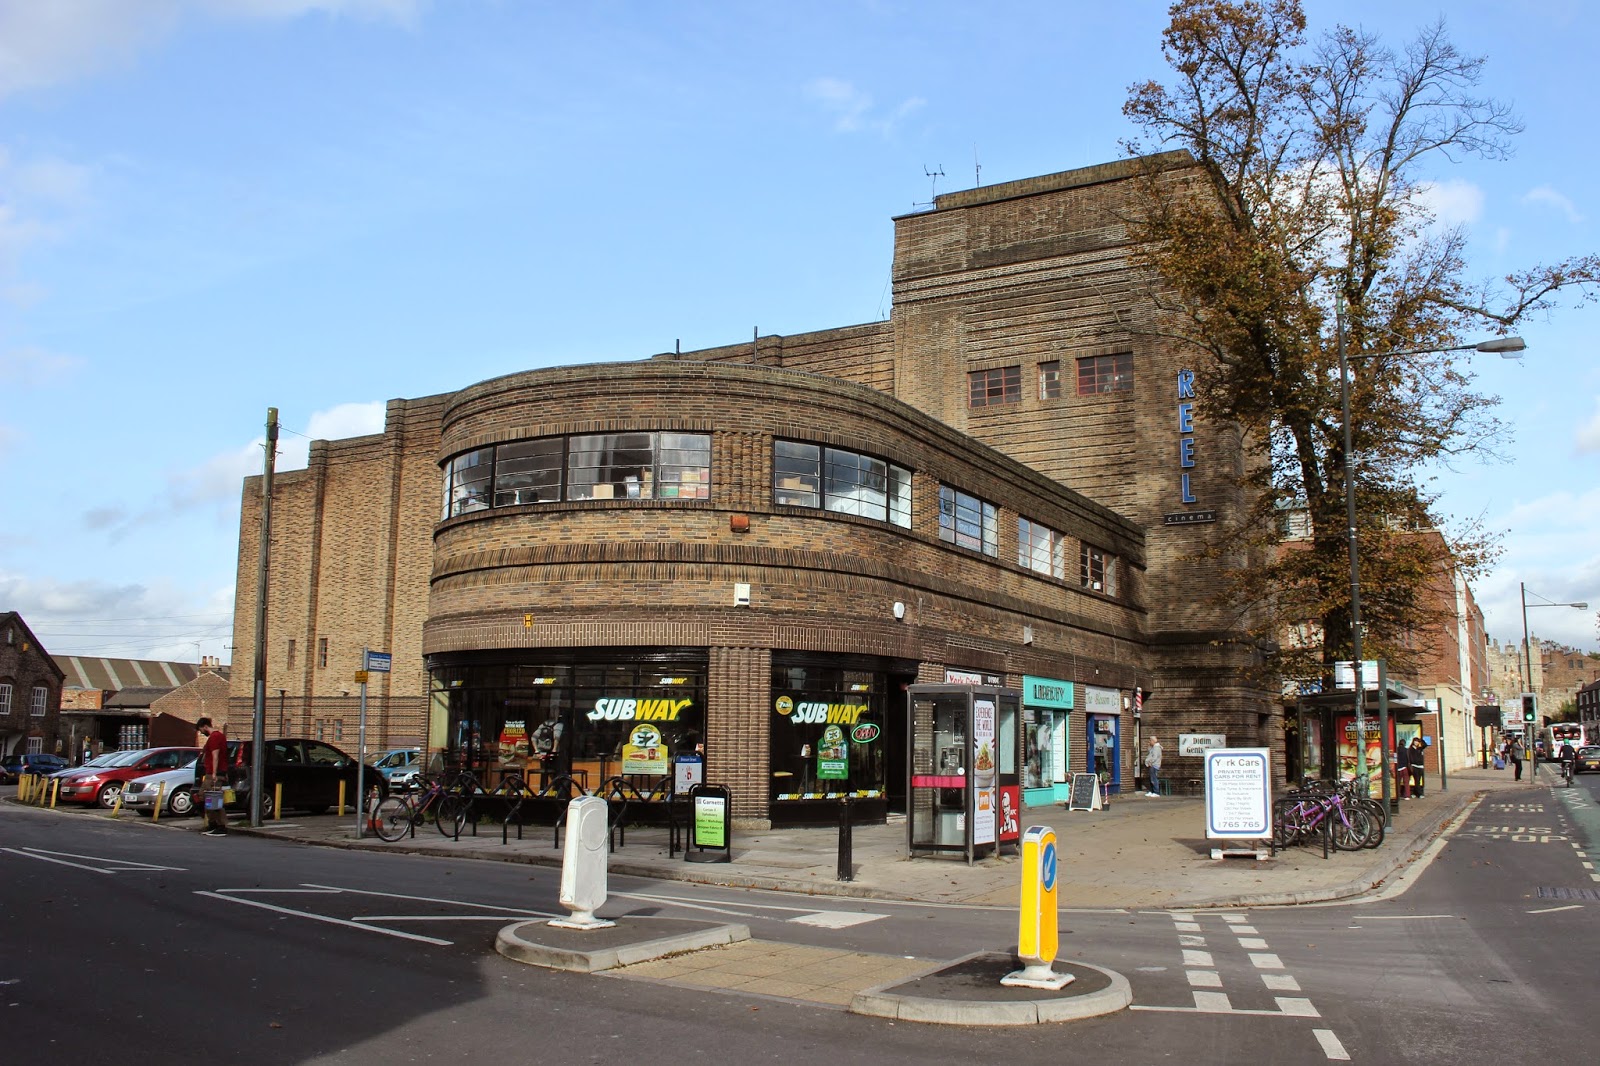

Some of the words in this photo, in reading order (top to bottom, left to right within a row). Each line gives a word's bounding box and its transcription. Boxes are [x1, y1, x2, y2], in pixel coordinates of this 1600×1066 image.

[1177, 368, 1197, 503] REEL
[1167, 513, 1212, 522] cinema
[659, 677, 688, 685] SUBWAY
[1033, 684, 1065, 702] LIBERTY
[587, 698, 692, 720] SUBWAY
[791, 702, 867, 724] SUBWAY
[631, 732, 660, 748] £2
[826, 729, 841, 741] £3
[855, 727, 876, 740] OPEN
[1192, 737, 1212, 745] Didim
[1215, 758, 1236, 767] Yrk
[1238, 758, 1260, 767] Cars
